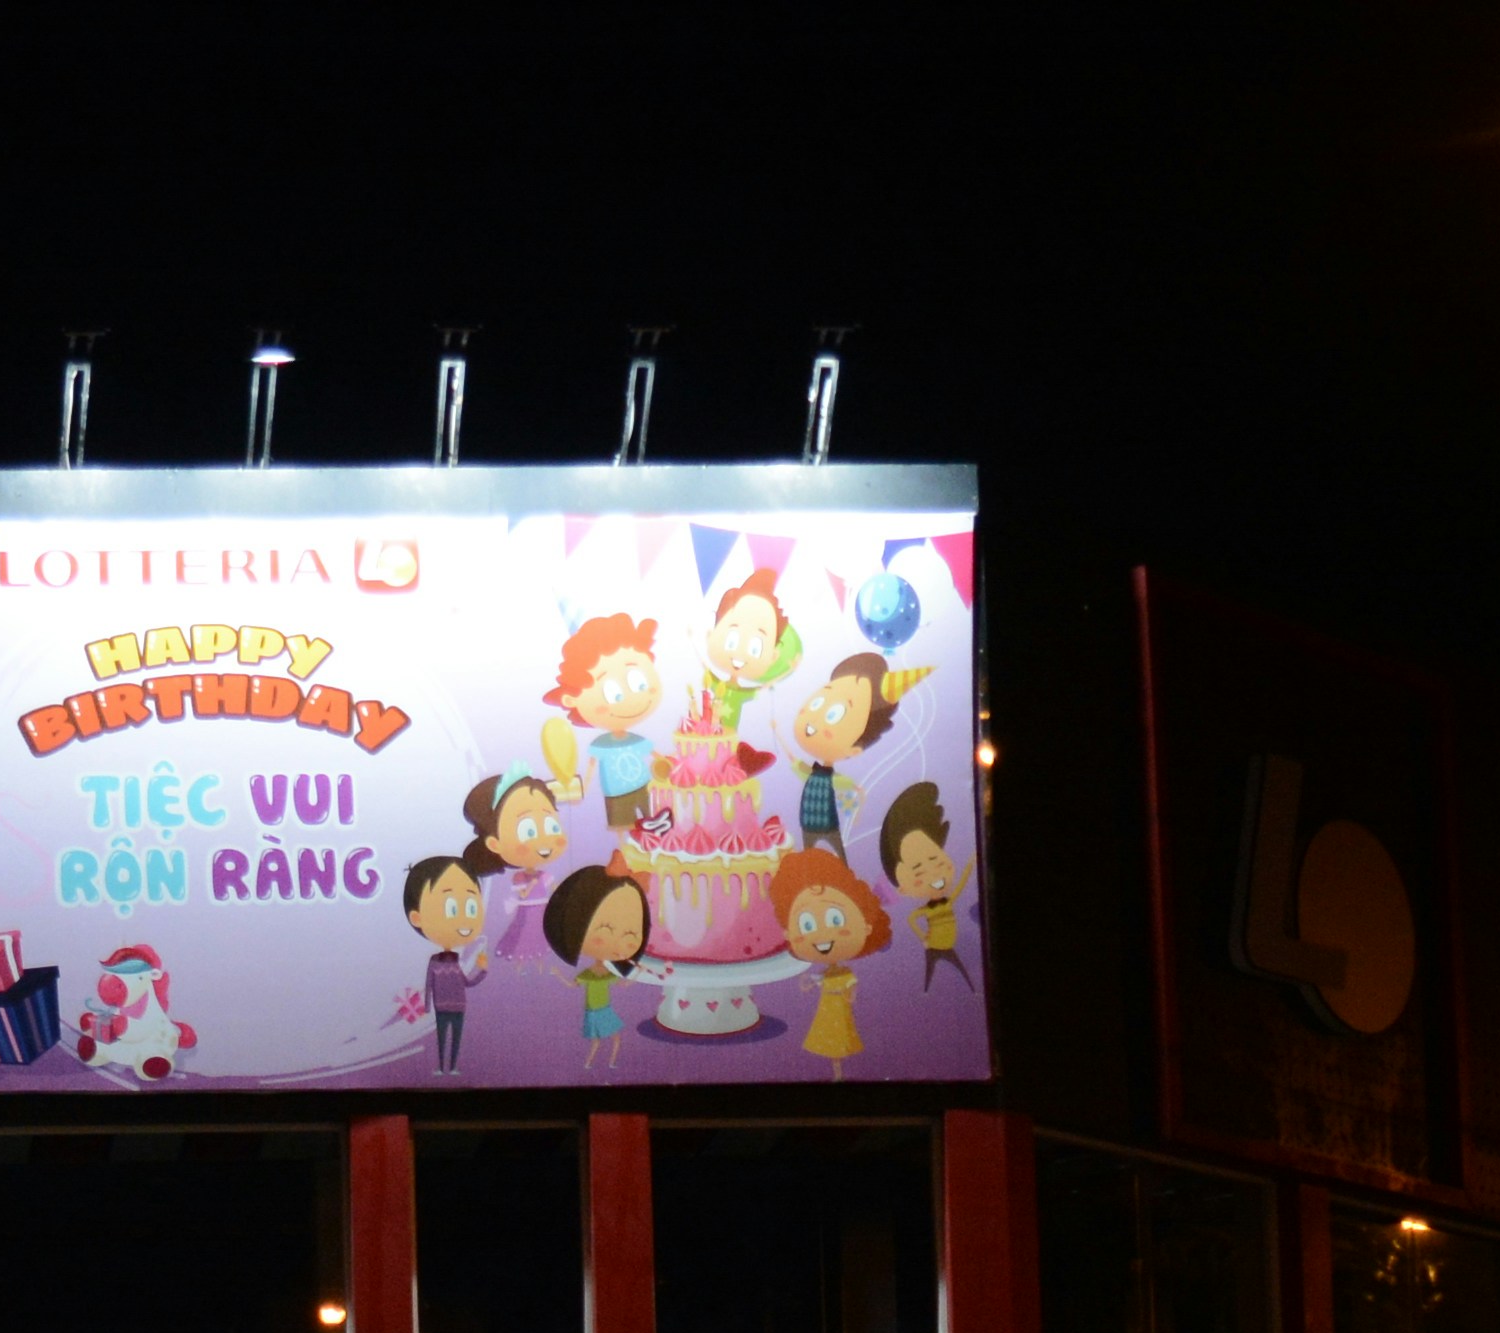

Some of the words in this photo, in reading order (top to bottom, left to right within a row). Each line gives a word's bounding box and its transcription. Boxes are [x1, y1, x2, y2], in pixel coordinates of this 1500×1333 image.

[0, 547, 332, 588] LOTTERIA
[85, 623, 333, 680] HAPPY
[18, 673, 411, 757] BIRTHDAY
[81, 761, 226, 840] TIỆC
[249, 774, 355, 825] VUI
[60, 837, 186, 916] RỘN
[211, 834, 381, 900] RÀNG
